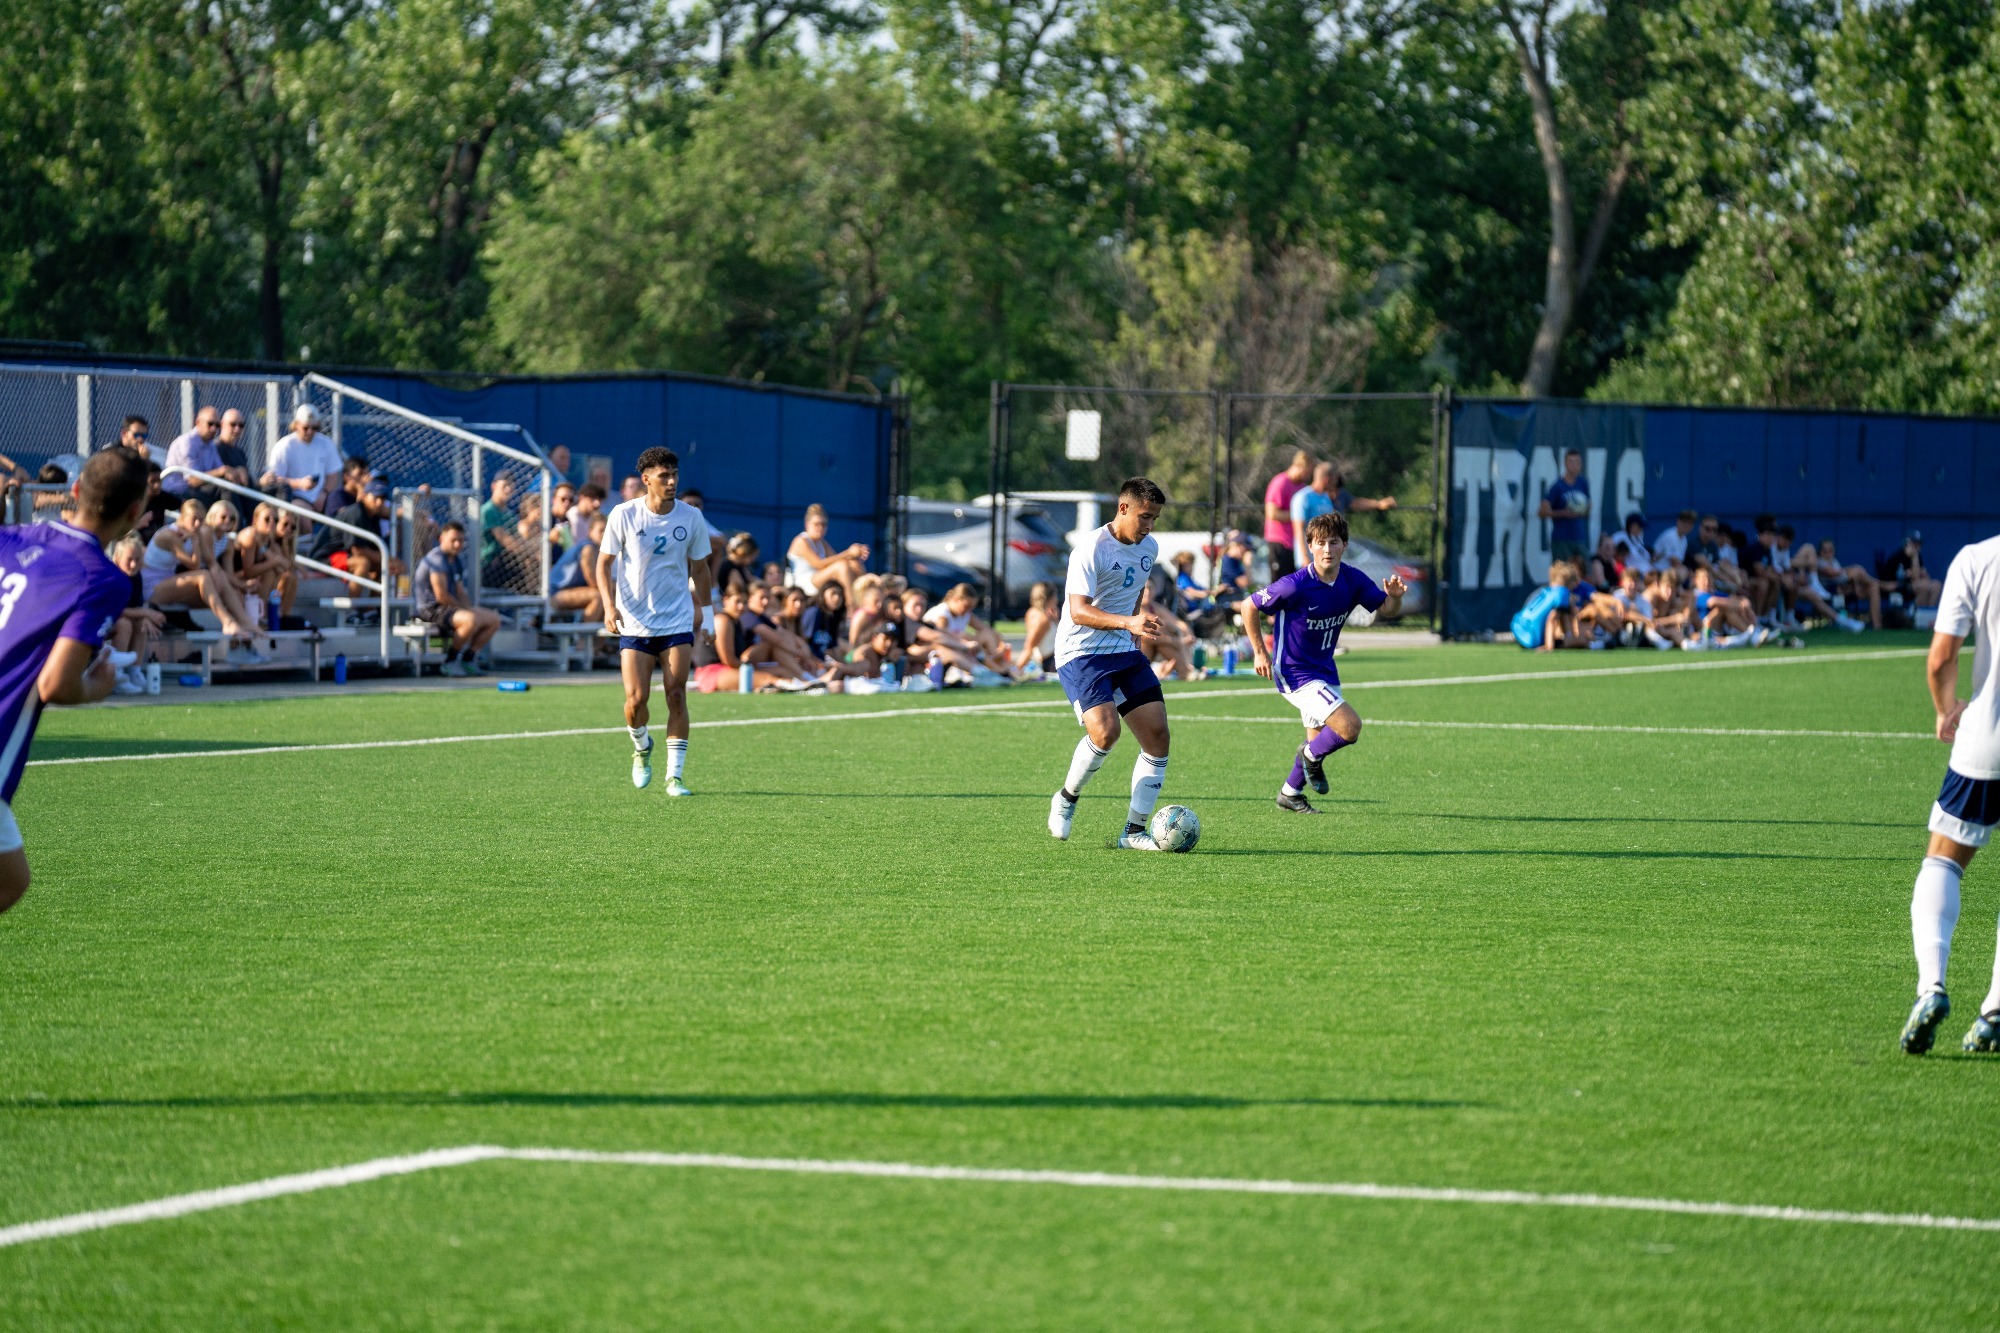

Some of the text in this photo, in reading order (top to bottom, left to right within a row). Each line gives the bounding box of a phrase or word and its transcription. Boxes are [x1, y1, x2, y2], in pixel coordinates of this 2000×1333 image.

[653, 535, 667, 555] 2
[1122, 566, 1135, 588] 6
[0, 566, 28, 631] 3
[1321, 629, 1334, 651] 11
[1317, 686, 1339, 706] 11
